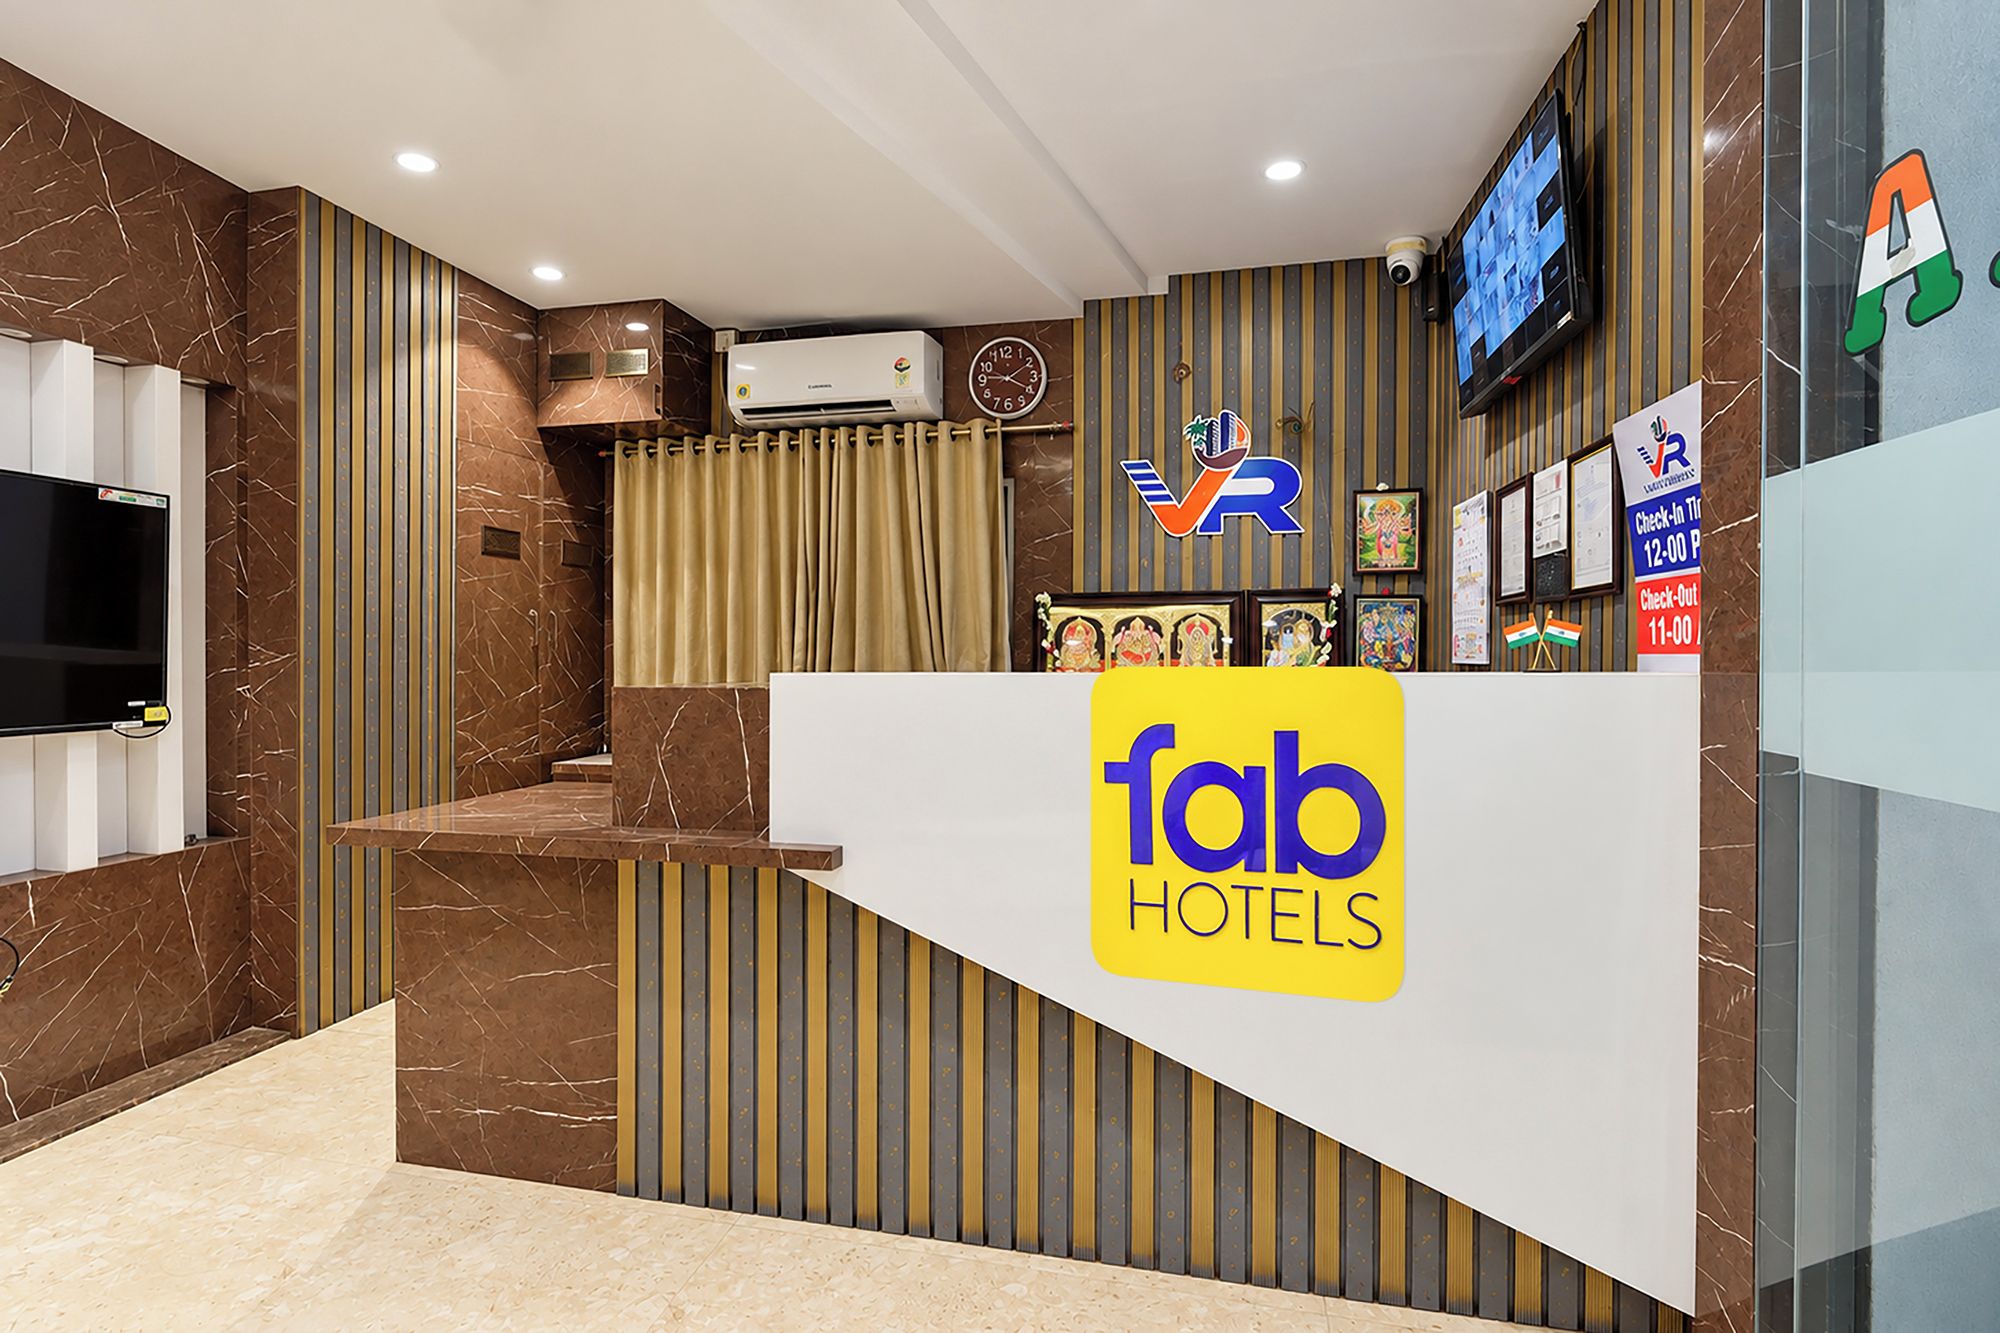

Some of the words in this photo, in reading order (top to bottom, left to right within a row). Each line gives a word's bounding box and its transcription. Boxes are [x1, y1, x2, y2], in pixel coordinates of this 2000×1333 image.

[999, 345, 1012, 359] 12
[1025, 357, 1033, 368] 2
[977, 373, 987, 387] 9
[980, 361, 993, 373] 10
[1030, 370, 1038, 383] 3
[993, 397, 1001, 410] 7
[1004, 397, 1013, 411] 6
[1637, 432, 1691, 479] VR
[1120, 456, 1305, 537] VR
[1635, 502, 1685, 535] Check-In
[1690, 529, 1701, 559] P
[1640, 582, 1698, 611] Check-Out
[1648, 614, 1693, 645] 11-00
[1104, 723, 1387, 880] fab
[1130, 878, 1383, 950] HOTELS
